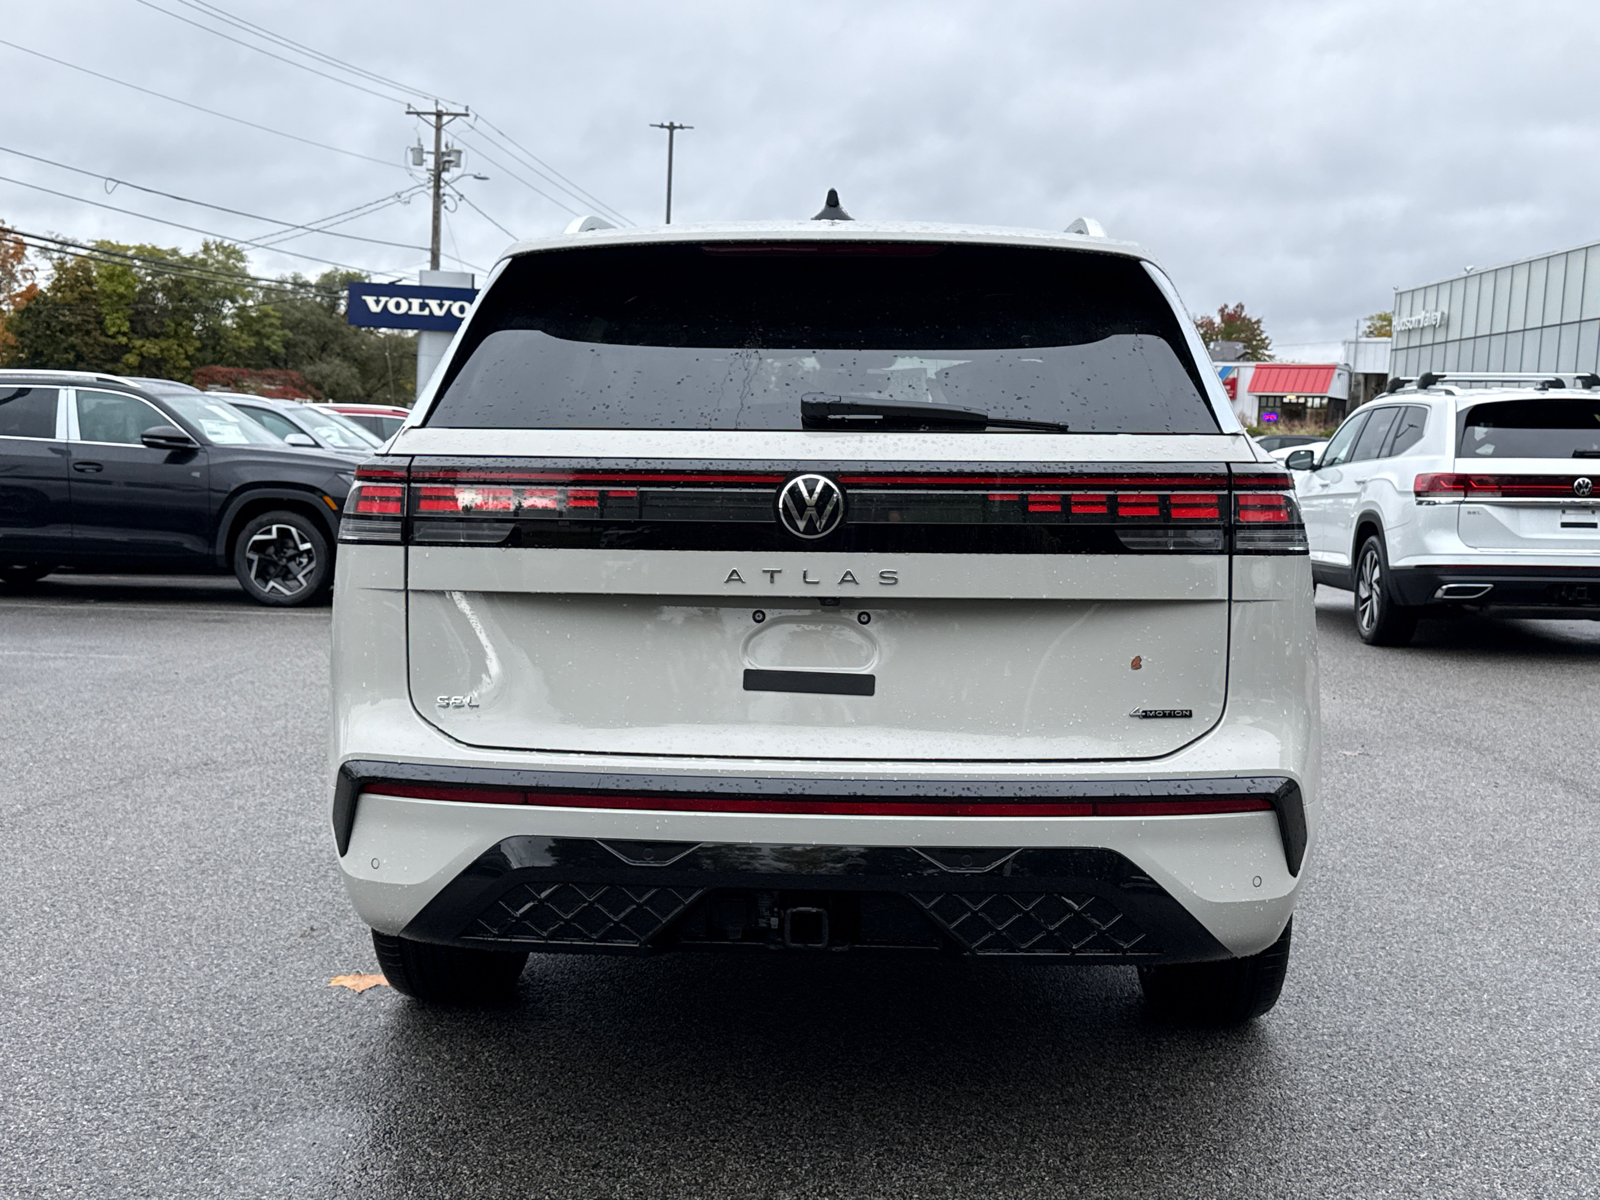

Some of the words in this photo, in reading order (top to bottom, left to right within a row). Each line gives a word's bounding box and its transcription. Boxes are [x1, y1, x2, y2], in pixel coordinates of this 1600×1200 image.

[361, 295, 471, 318] VOLVO
[724, 567, 899, 585] ATLAS
[436, 695, 480, 708] SEL
[1129, 706, 1192, 719] 4MOTION
